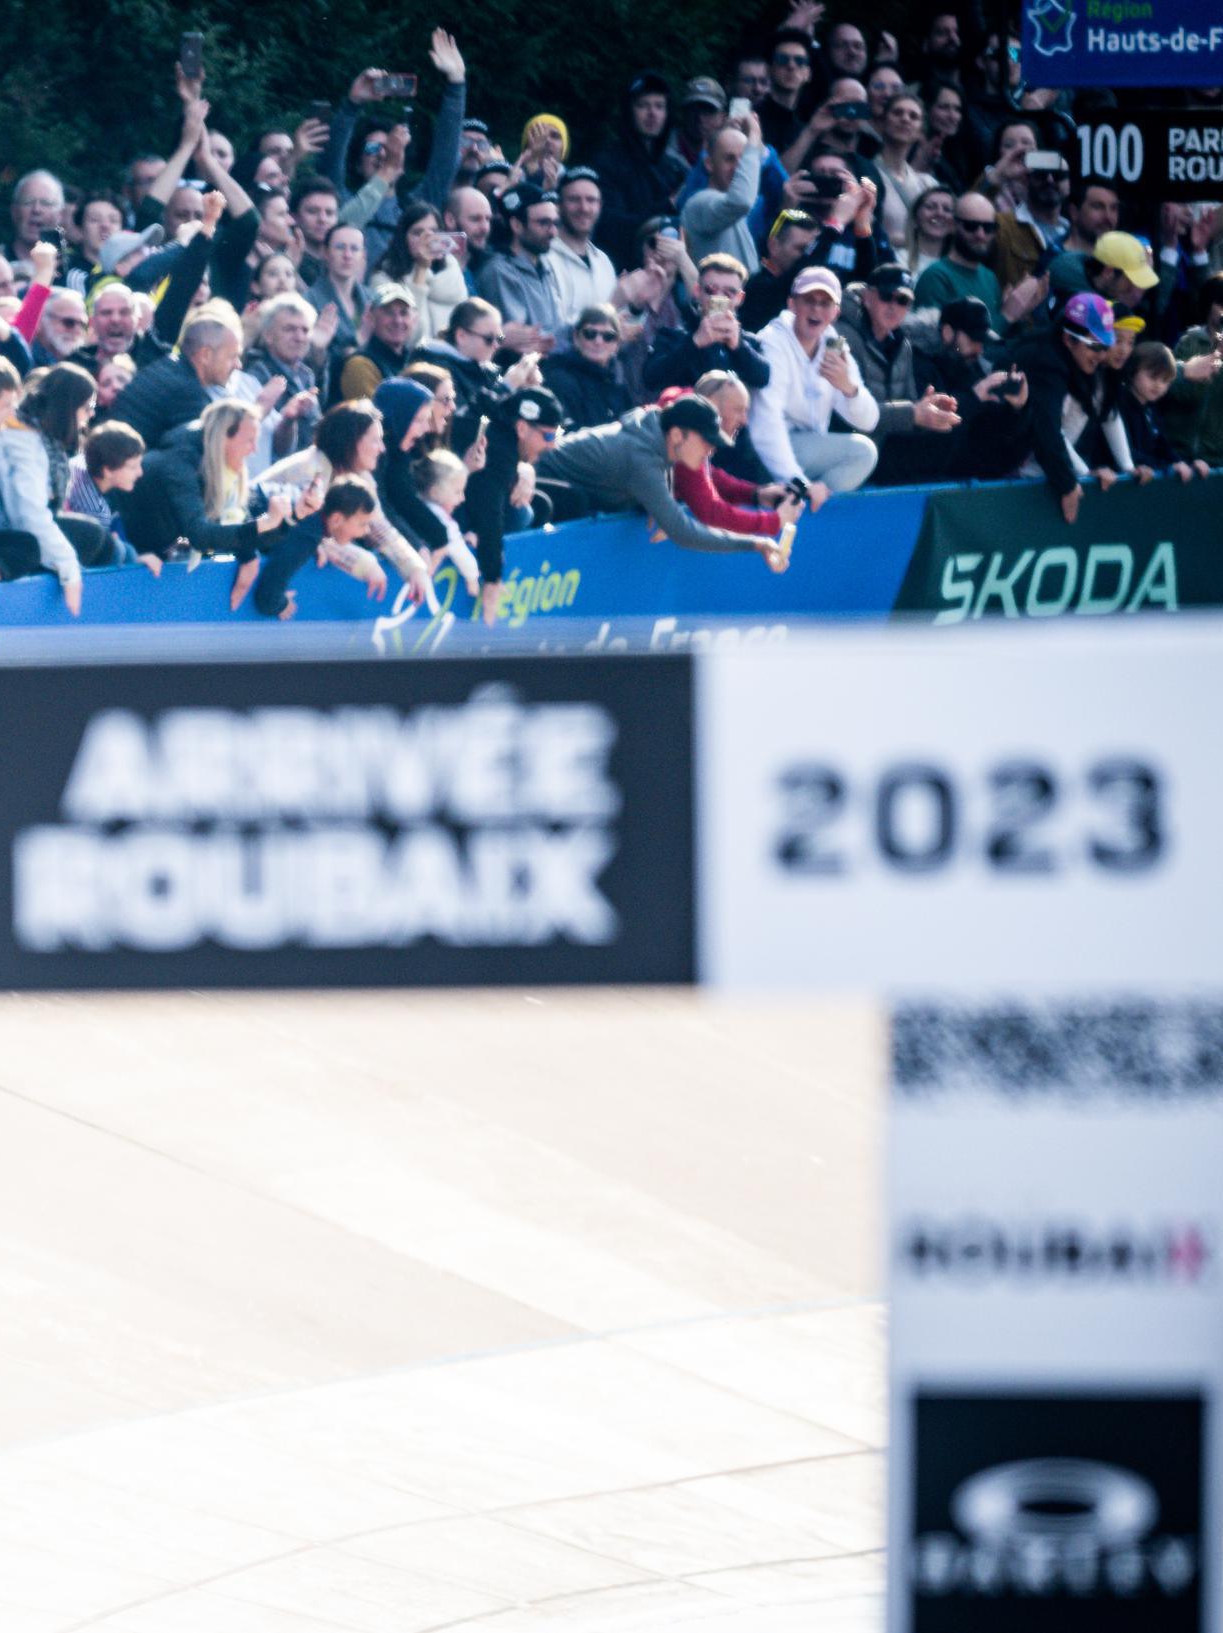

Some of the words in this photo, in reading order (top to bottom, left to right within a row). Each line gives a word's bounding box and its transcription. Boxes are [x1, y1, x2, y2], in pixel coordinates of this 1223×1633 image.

[1077, 123, 1144, 181] 100
[1168, 127, 1223, 153] PAR
[471, 560, 580, 629] égion
[64, 682, 619, 822] ARRIVÉE
[773, 755, 1165, 877] 2023
[14, 824, 617, 950] ROUBAIX
